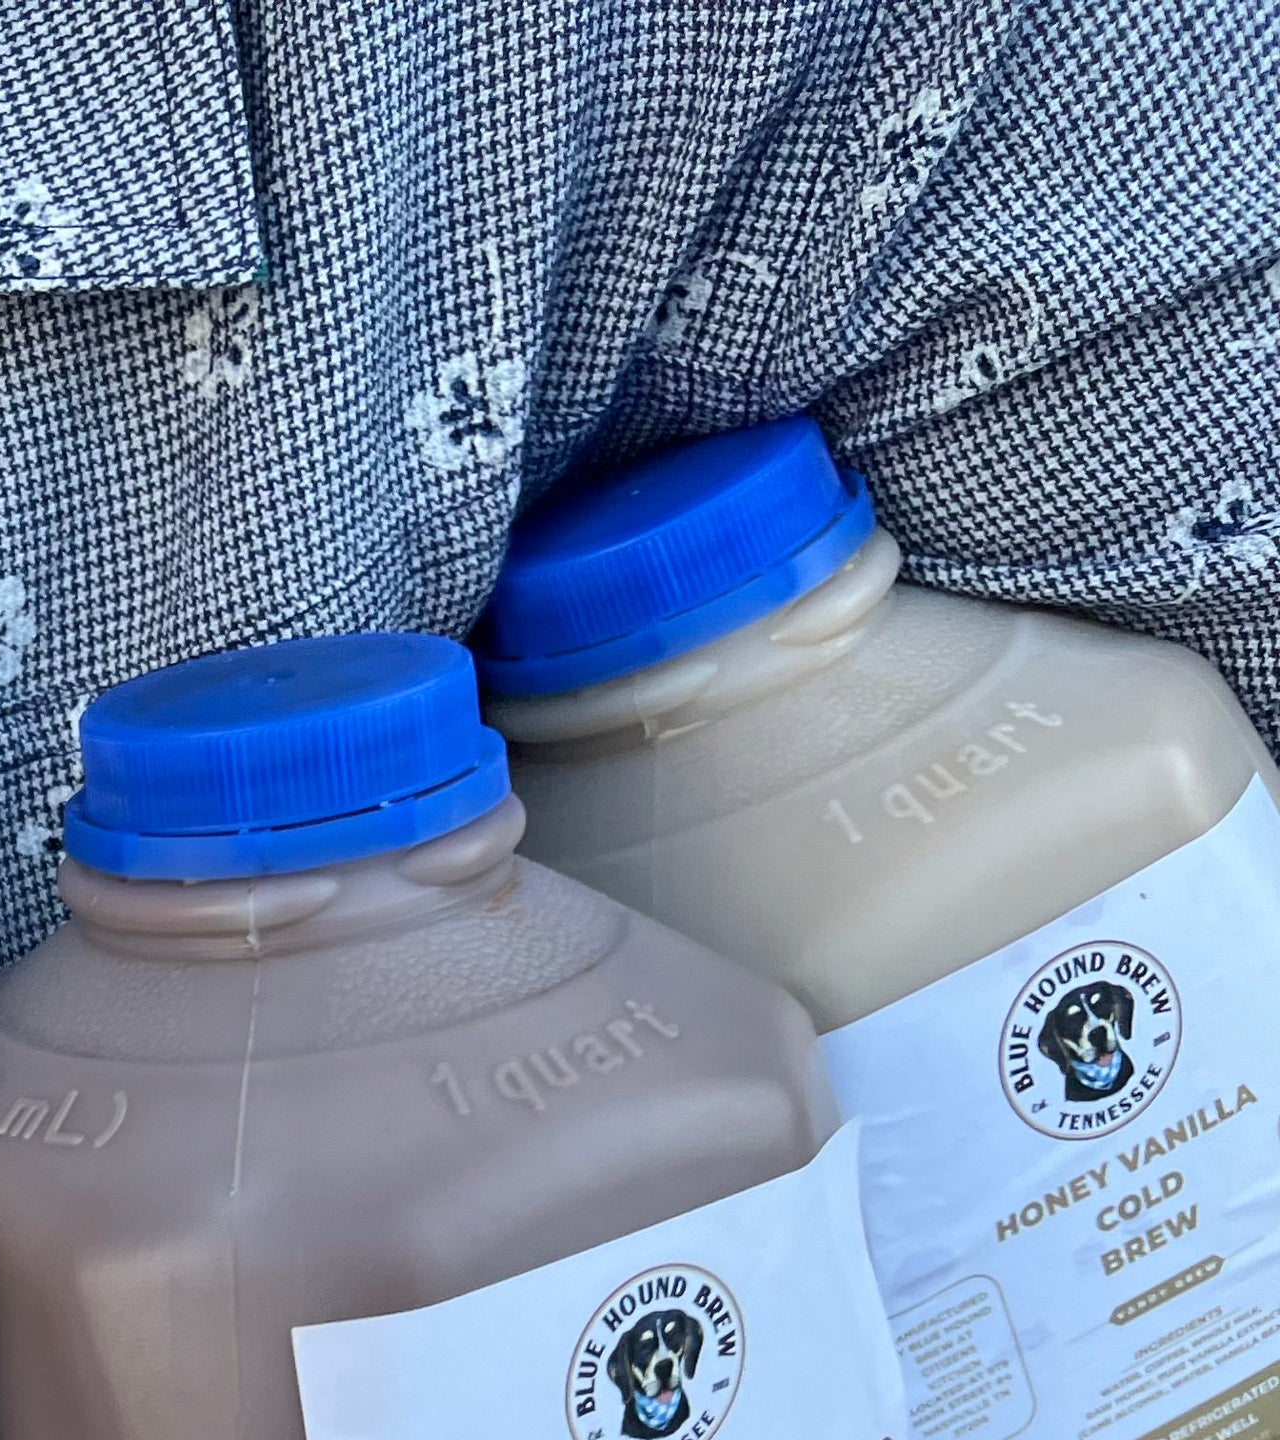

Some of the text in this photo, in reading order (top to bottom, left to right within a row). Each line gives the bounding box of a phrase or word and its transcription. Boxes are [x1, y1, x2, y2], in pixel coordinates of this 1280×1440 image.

[820, 698, 1064, 843] 1 quart
[431, 998, 684, 1117] 1 quart
[1009, 950, 1172, 1093] BLUE HOUND BREW
[1058, 1063, 1163, 1130] TENNESSEE
[995, 1084, 1257, 1242] HONEY VANILLA
[1096, 1171, 1183, 1231] COLD
[1100, 1203, 1196, 1276] BREW
[575, 1276, 736, 1417] BLUE HOUND BREW
[1134, 1306, 1222, 1359] INGREDIENTS
[1215, 1413, 1258, 1440] WELL
